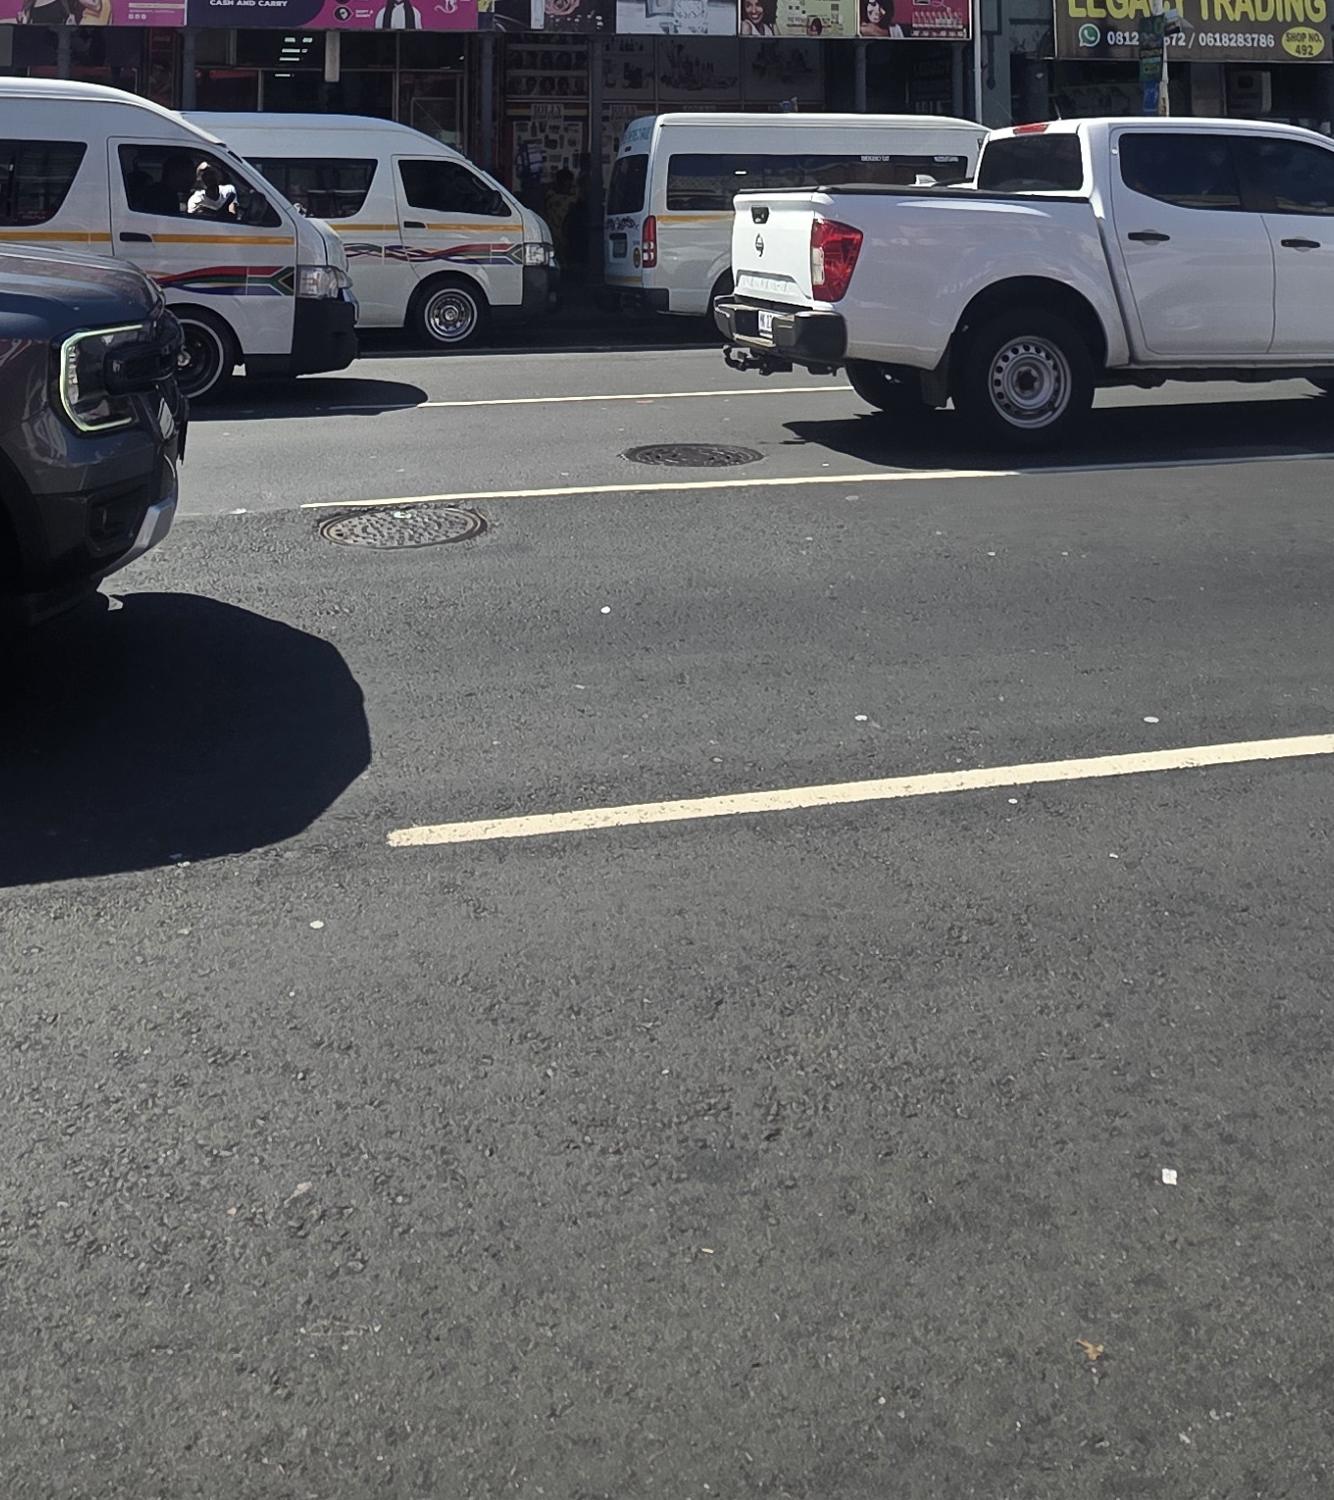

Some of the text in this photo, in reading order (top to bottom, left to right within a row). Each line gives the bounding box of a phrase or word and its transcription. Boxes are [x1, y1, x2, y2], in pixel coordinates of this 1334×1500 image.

[1107, 31, 1186, 46] 081272
[1198, 32, 1275, 48] 0618283786
[1285, 32, 1305, 43] SHOP
[1295, 45, 1315, 56] 492
